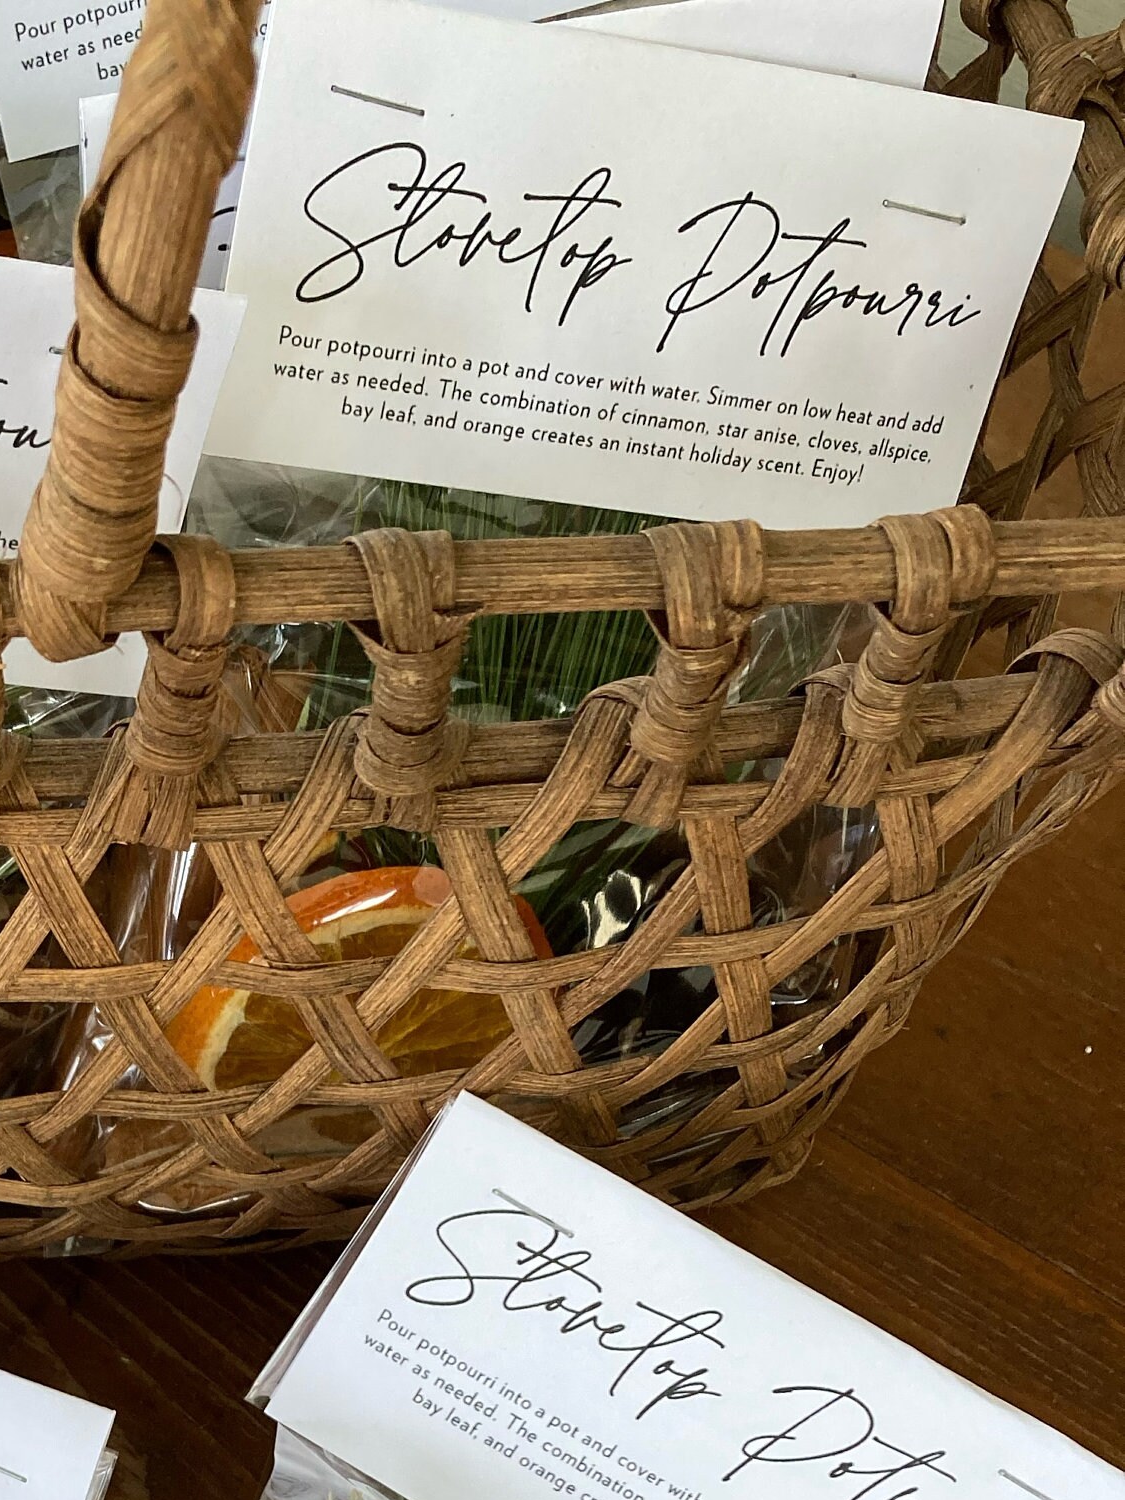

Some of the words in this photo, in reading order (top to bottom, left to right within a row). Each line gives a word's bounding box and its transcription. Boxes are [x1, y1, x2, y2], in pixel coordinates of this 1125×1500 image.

[14, 20, 57, 43] Pour
[295, 142, 633, 328] Stovetop
[655, 190, 983, 357] Potpourri
[273, 363, 325, 383] water
[330, 370, 351, 386] as
[356, 371, 429, 397] needed.
[438, 377, 473, 403] The
[479, 388, 592, 420] combination
[597, 401, 620, 424] of
[621, 411, 710, 438] cinnamon,
[716, 421, 751, 440] star
[753, 425, 801, 449] anise,
[807, 428, 863, 457] cloves,
[868, 433, 932, 464] allspice,
[278, 324, 323, 351] Pour
[326, 339, 416, 364] potpourri
[420, 352, 458, 370] into
[461, 358, 473, 372] a
[477, 360, 511, 379] pot
[514, 362, 551, 383] and
[554, 371, 605, 390] cover
[609, 375, 646, 396] with
[651, 384, 701, 404] water.
[706, 384, 773, 413] Simmer
[776, 401, 799, 416] on
[802, 397, 833, 422] low
[834, 401, 874, 426] heat
[875, 410, 910, 431] and
[911, 413, 945, 435] add
[341, 394, 375, 424] bay
[379, 399, 418, 427] leaf,
[423, 409, 459, 430] and
[462, 419, 526, 443] orange
[531, 428, 595, 449] creates
[598, 437, 621, 452] an
[625, 435, 686, 461] instant
[688, 440, 753, 473] holiday
[756, 457, 805, 476] scent.
[810, 457, 865, 487] Enjoy!
[404, 1208, 723, 1420] Stovetop
[364, 1334, 410, 1366] water
[411, 1363, 431, 1380] as
[433, 1376, 500, 1422] needed.
[506, 1412, 538, 1444] The
[376, 1308, 417, 1341] Pour
[415, 1338, 499, 1390] potpourri
[498, 1382, 533, 1410] into
[534, 1407, 546, 1419] a
[546, 1415, 580, 1439] pot
[580, 1435, 619, 1459] and
[617, 1456, 666, 1487] cover
[411, 1387, 444, 1417] bay
[444, 1406, 483, 1440] leaf,
[483, 1435, 520, 1459] and
[518, 1456, 577, 1495] orange
